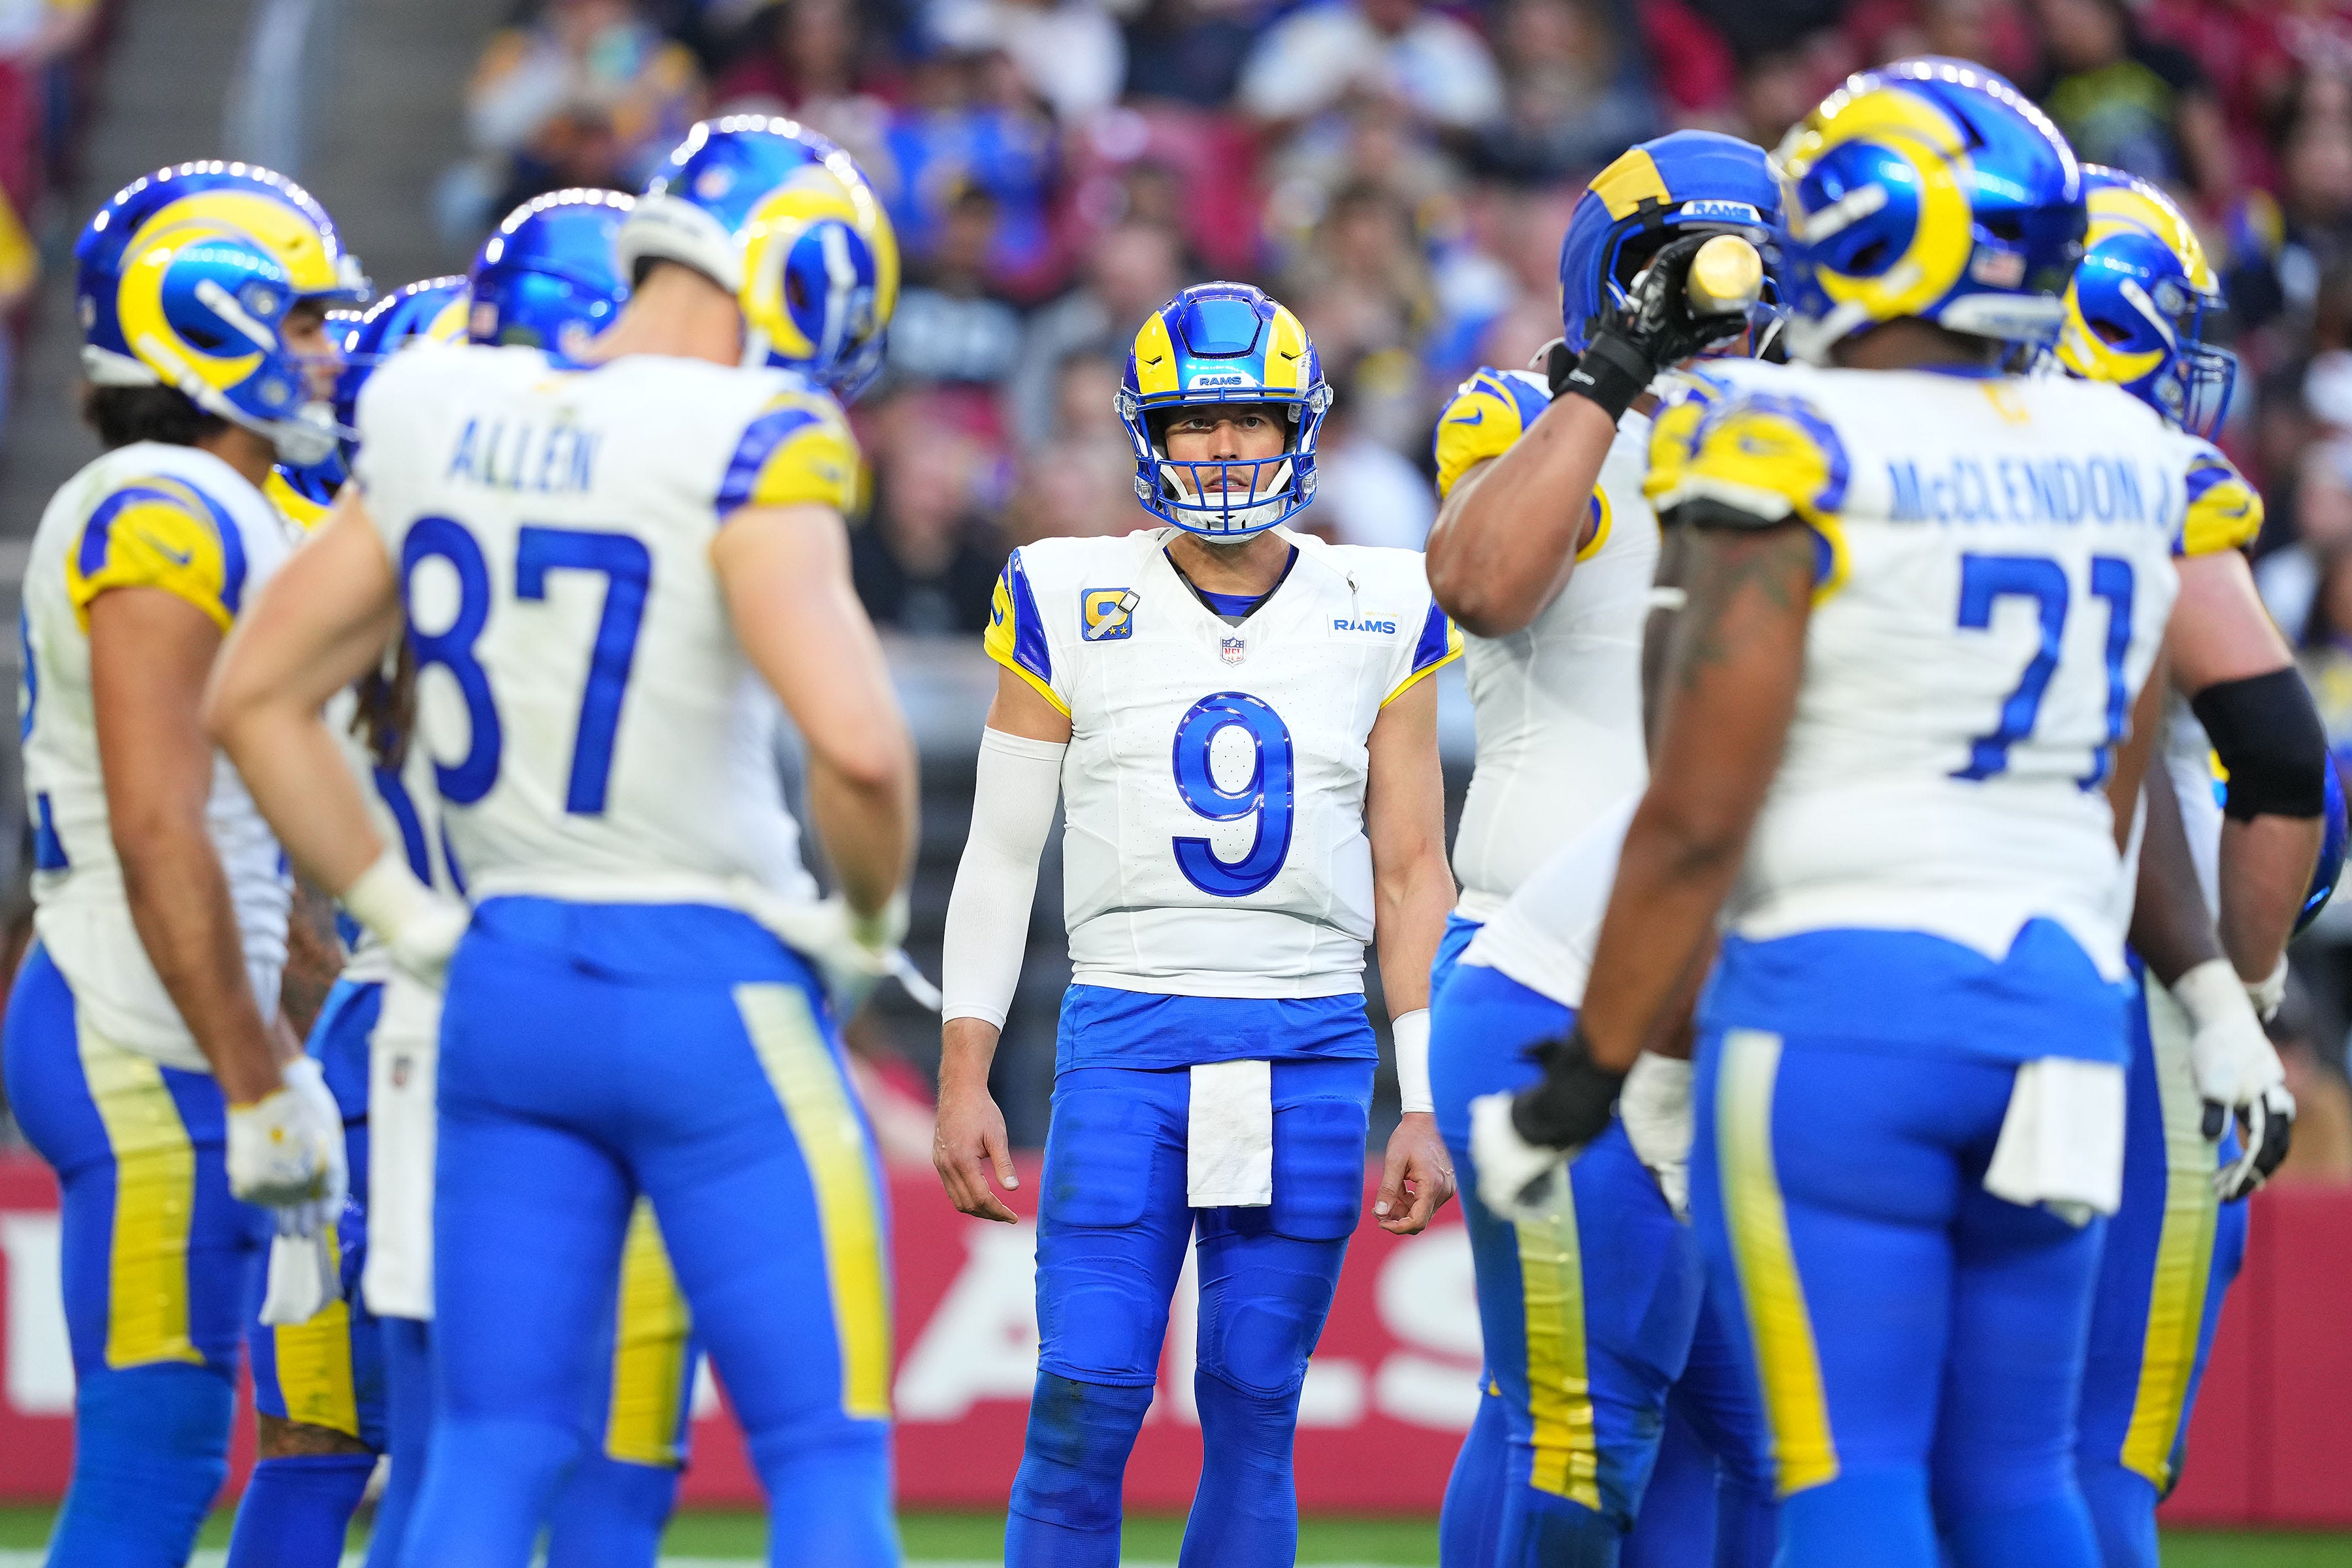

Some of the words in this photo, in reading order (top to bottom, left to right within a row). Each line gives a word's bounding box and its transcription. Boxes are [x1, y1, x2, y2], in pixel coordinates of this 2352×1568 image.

[1200, 376, 1242, 386] RAMS
[445, 417, 602, 493] ALLEN
[1224, 647, 1243, 661] NFL
[1334, 619, 1396, 634] RAMS
[401, 515, 653, 815] 87
[1948, 553, 2134, 791] 71
[1172, 691, 1294, 898] 9
